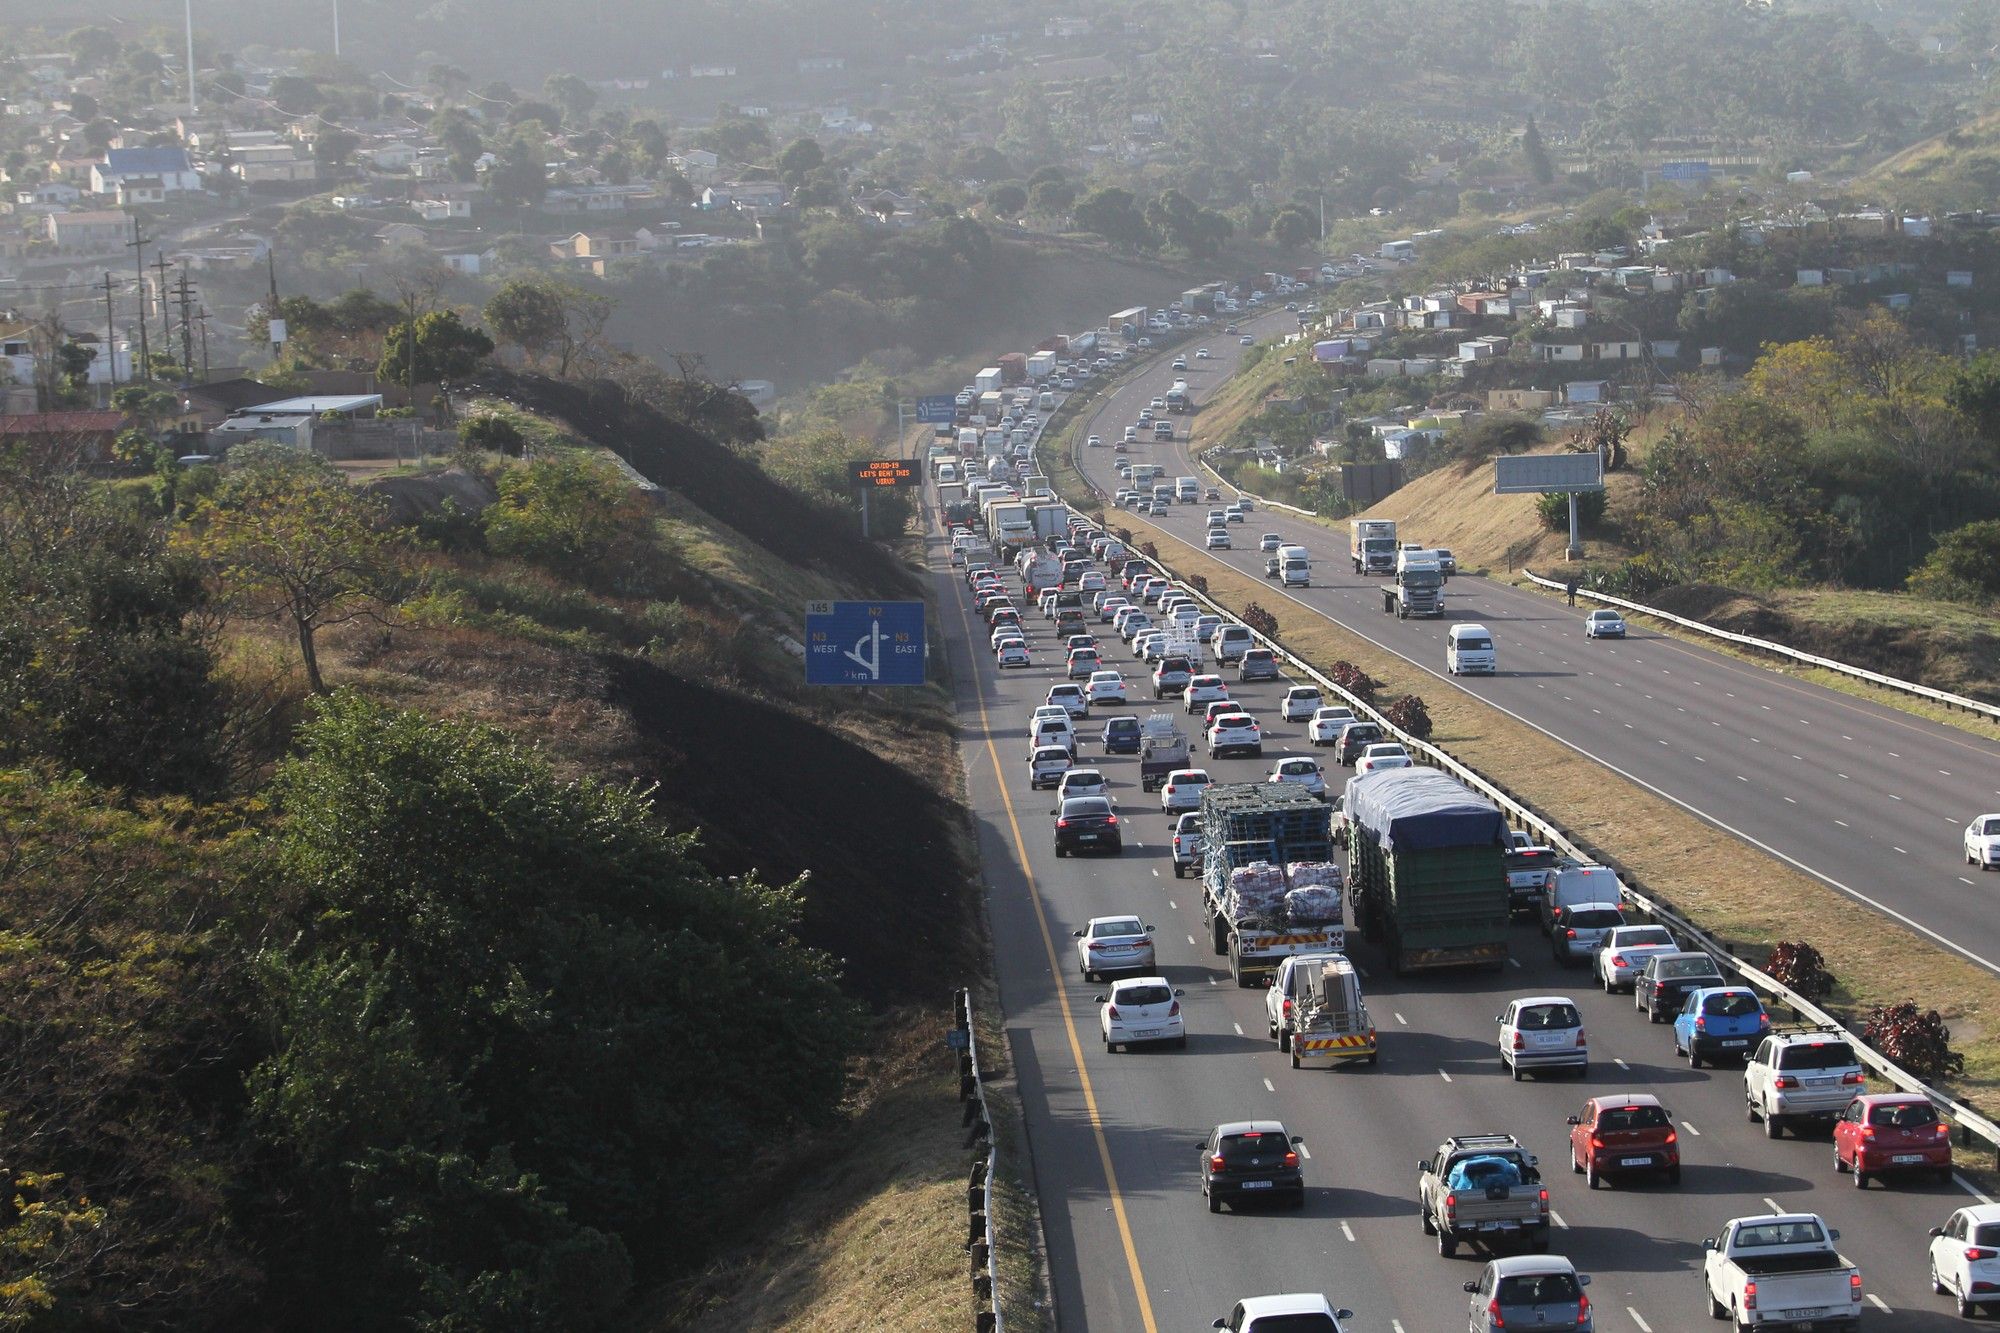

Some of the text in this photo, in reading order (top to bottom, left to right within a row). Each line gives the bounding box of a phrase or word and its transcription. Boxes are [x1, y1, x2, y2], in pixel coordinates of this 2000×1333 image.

[811, 603, 828, 613] 165
[869, 608, 882, 616] N2
[813, 633, 826, 641] N3
[896, 633, 909, 641] N3
[813, 645, 837, 653] WEST
[895, 645, 917, 653] EAST
[851, 670, 867, 679] km
